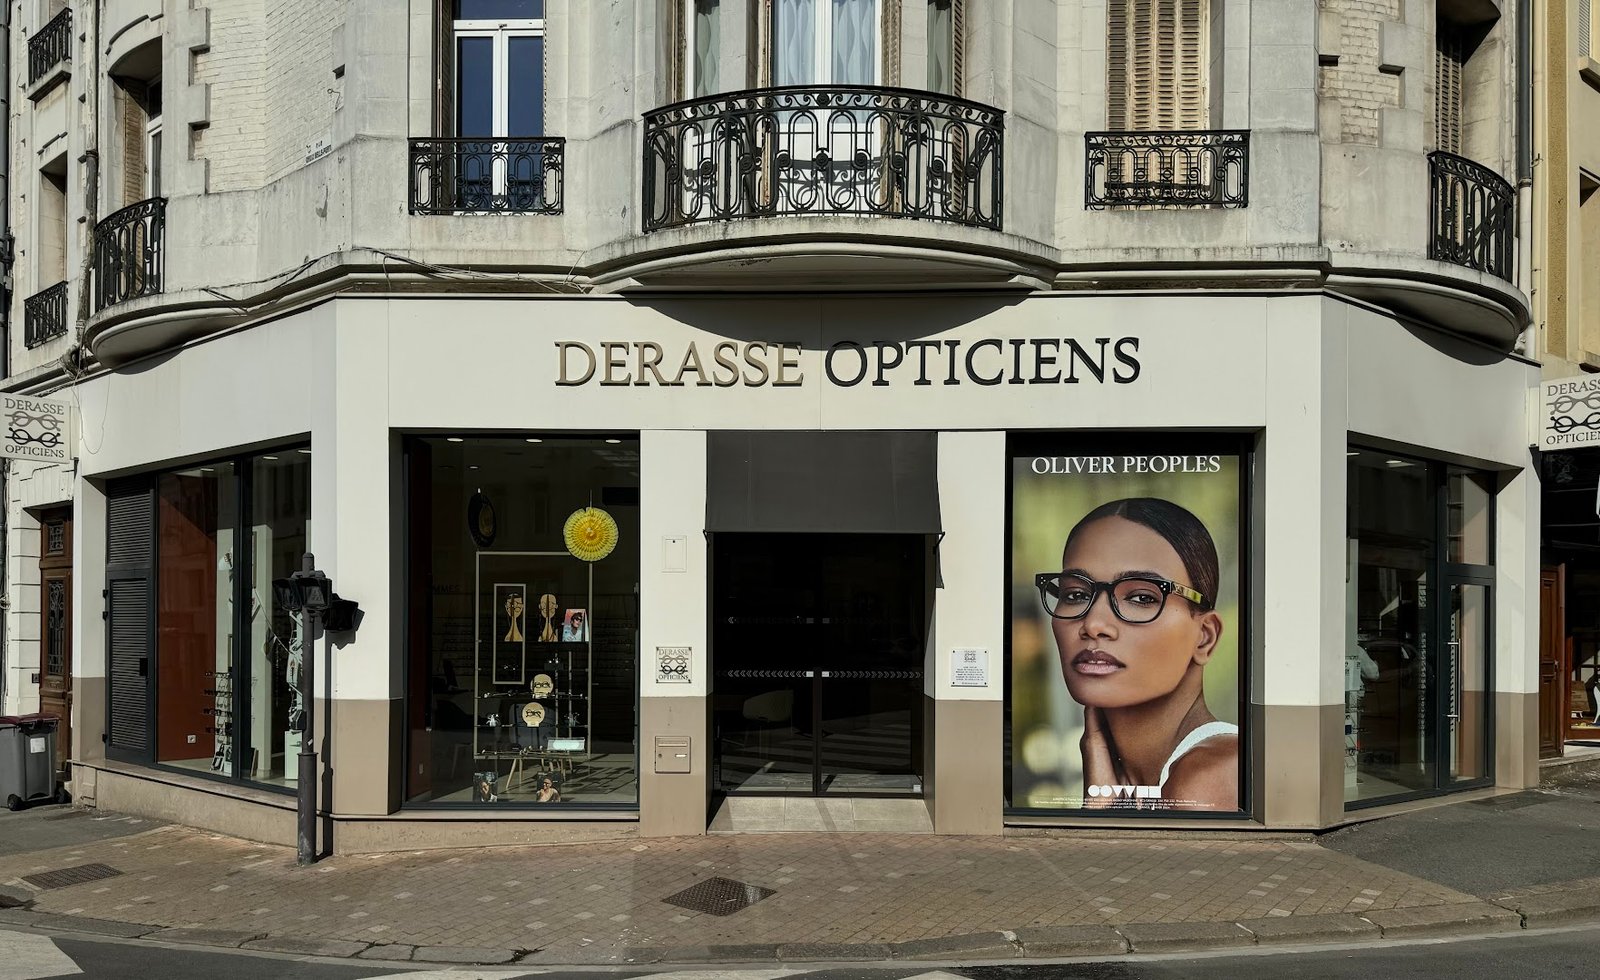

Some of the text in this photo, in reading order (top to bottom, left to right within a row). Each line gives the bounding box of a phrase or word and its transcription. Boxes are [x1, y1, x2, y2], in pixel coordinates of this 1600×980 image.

[554, 338, 1141, 387] DERASSE OPTICIENS
[5, 398, 64, 415] DERASSE
[5, 444, 65, 458] OPTICIENS
[1032, 455, 1221, 474] OLIVER PEOPLES
